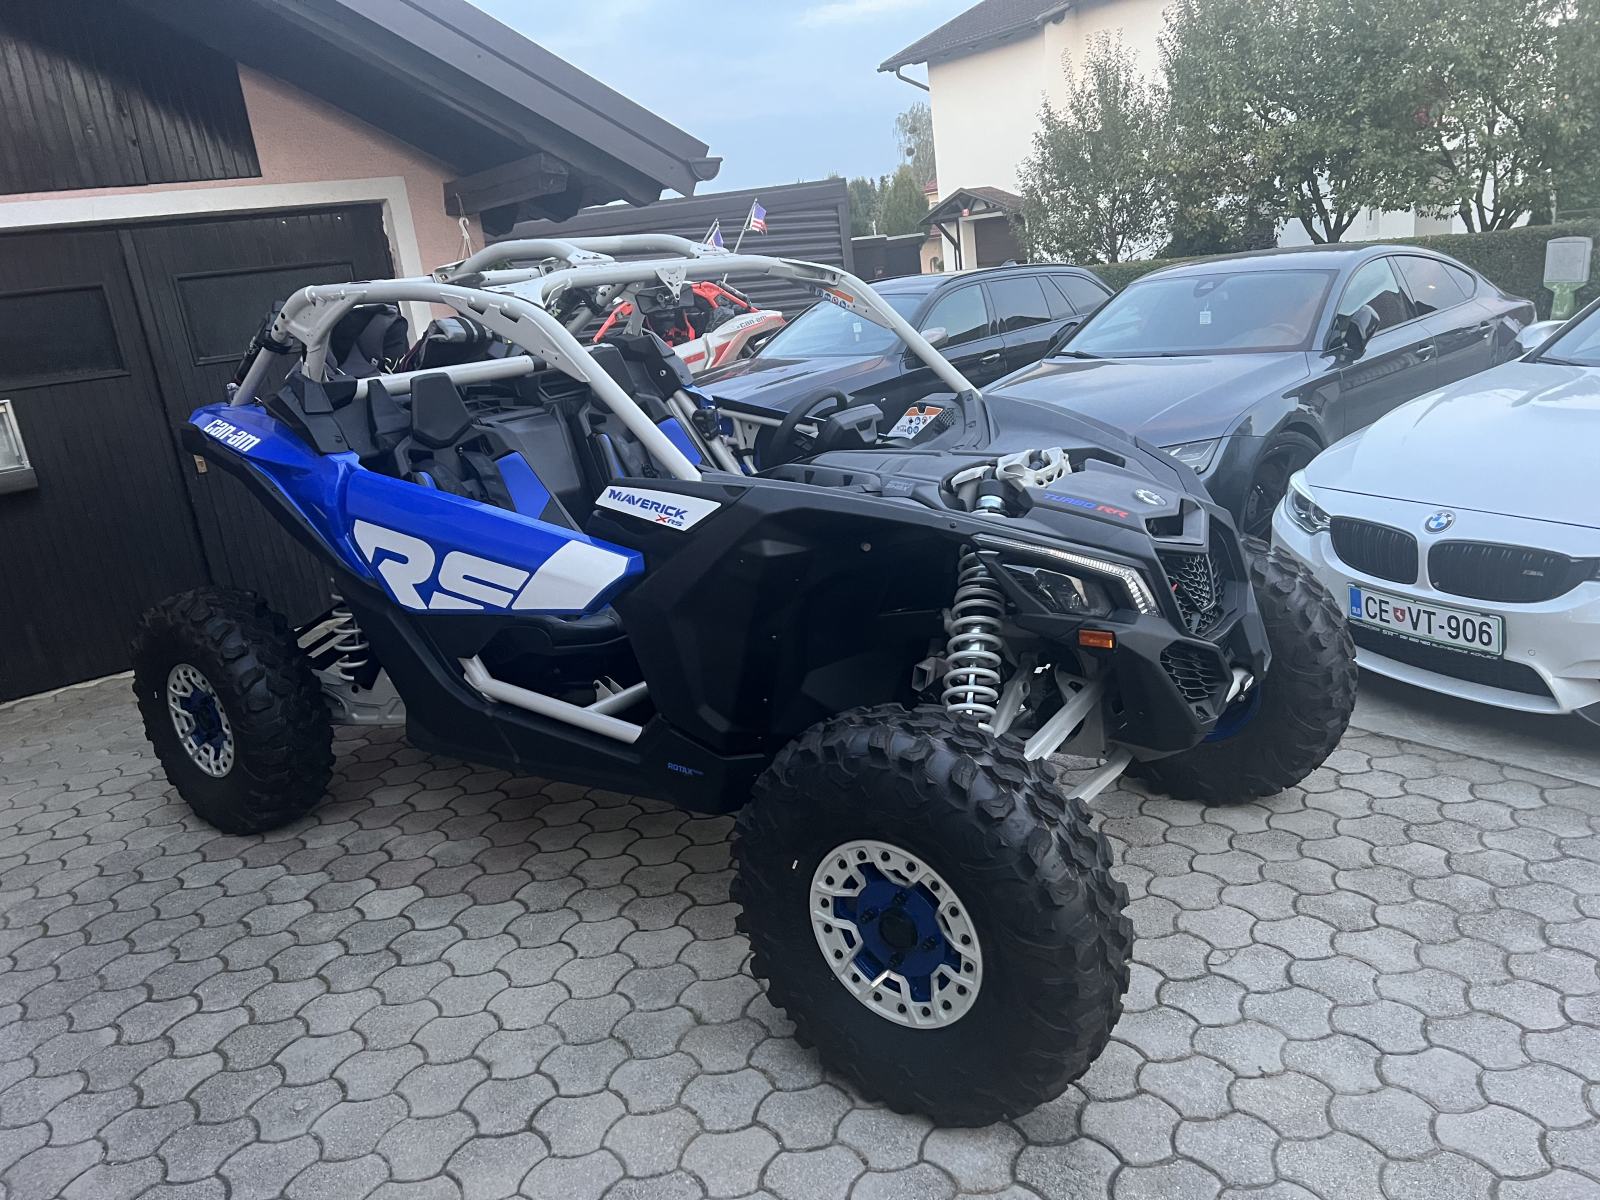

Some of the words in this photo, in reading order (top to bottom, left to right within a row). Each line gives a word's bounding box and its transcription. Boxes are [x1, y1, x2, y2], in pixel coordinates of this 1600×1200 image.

[203, 418, 261, 452] can-am
[608, 488, 688, 520] MAVERICK
[1043, 492, 1097, 510] TURBO
[1096, 504, 1129, 519] RR
[353, 519, 530, 610] RS
[1365, 595, 1391, 624] CE
[1407, 606, 1493, 647] VT-906
